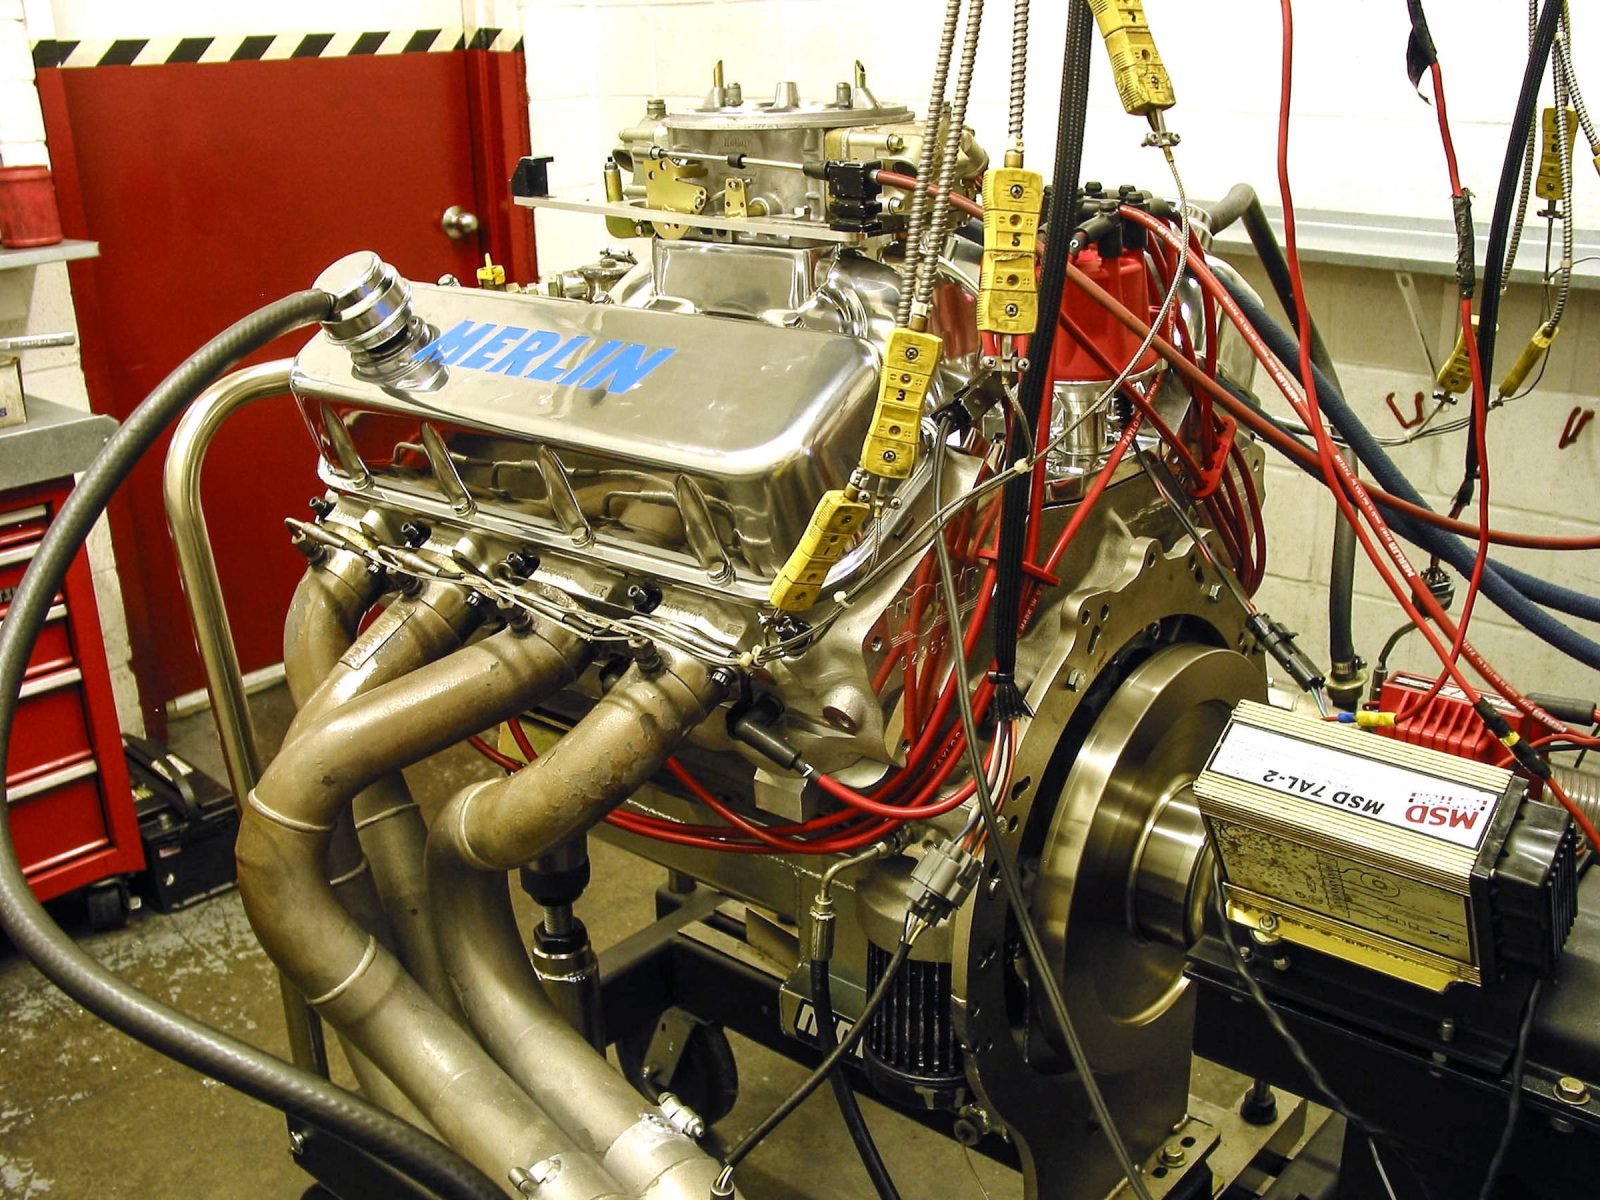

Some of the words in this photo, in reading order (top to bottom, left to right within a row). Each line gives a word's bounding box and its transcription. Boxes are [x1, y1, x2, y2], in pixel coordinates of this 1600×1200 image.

[411, 320, 678, 394] MERLIN
[895, 389, 906, 401] 3
[1334, 453, 1351, 477] TAYLOR
[1353, 484, 1364, 497] USA
[1387, 540, 1415, 578] MERLIN
[1262, 769, 1326, 798] 7AL-2
[1332, 791, 1385, 815] MSD
[1405, 805, 1479, 829] MSD
